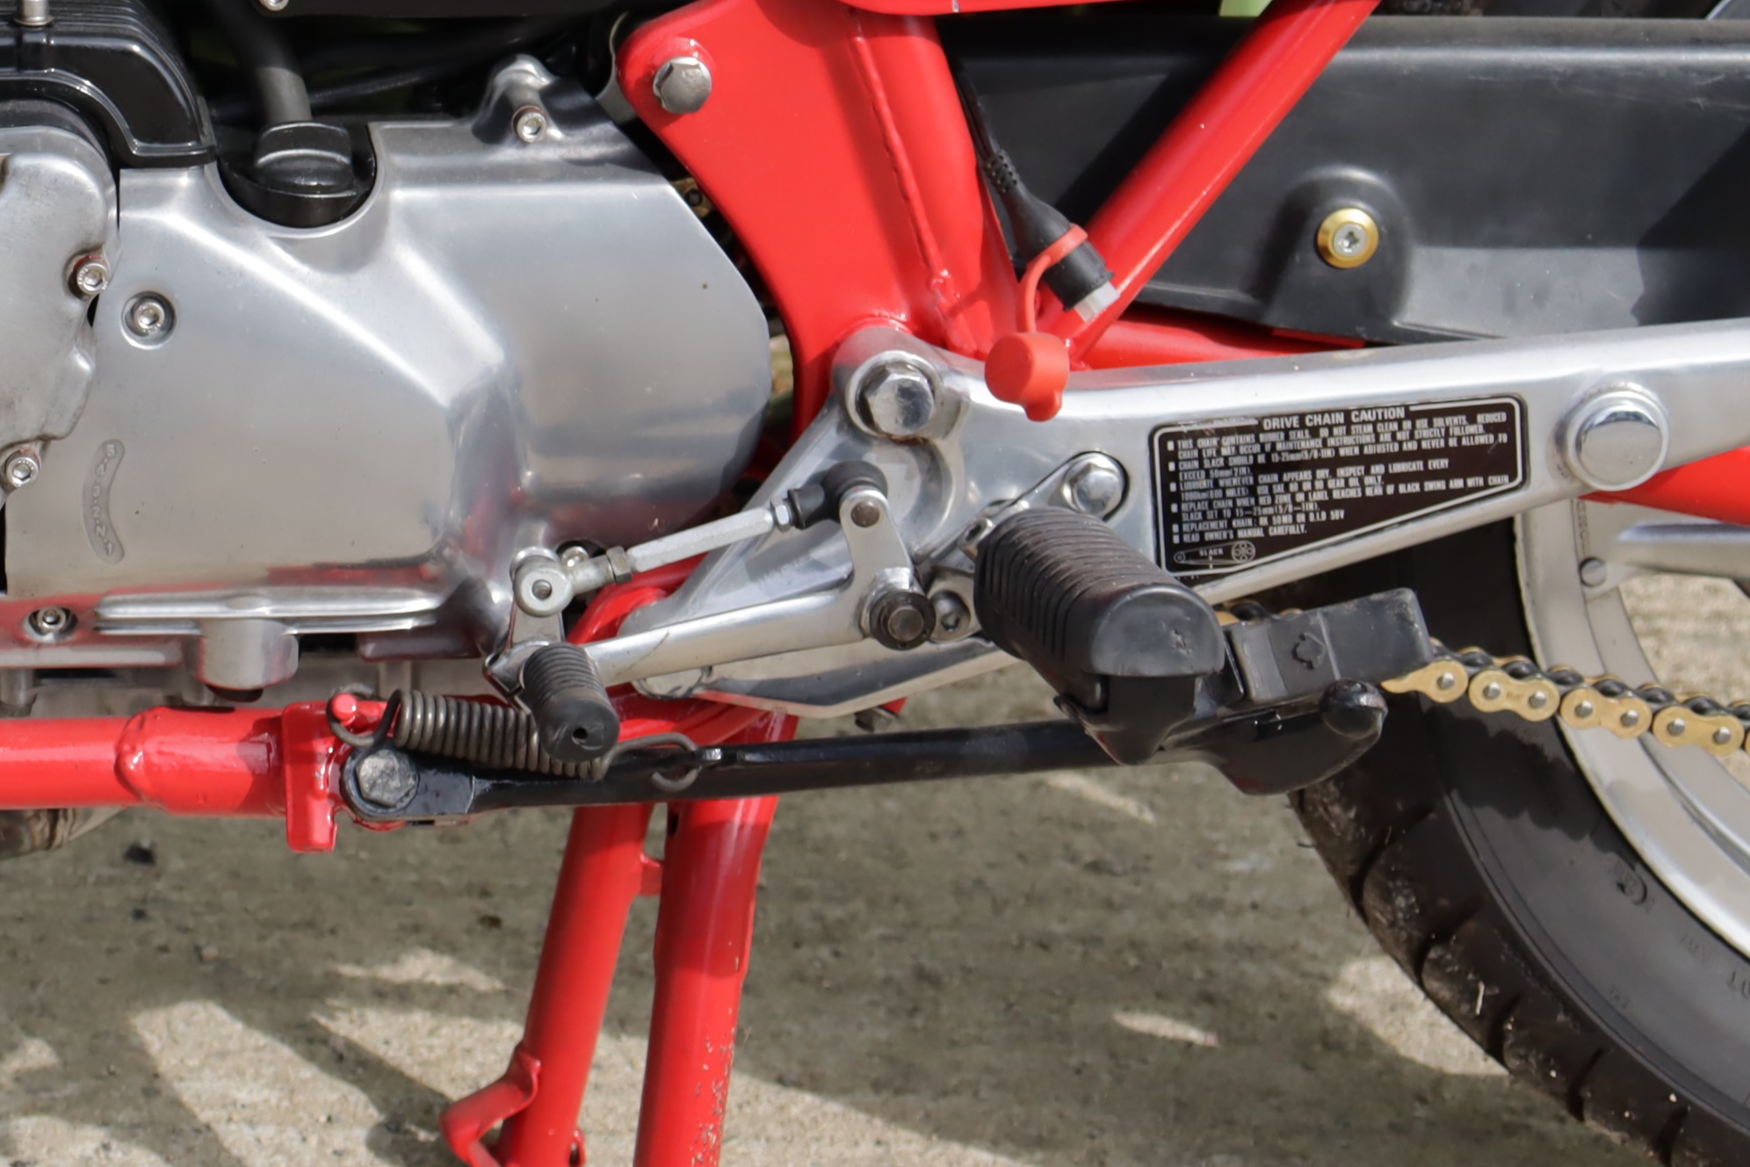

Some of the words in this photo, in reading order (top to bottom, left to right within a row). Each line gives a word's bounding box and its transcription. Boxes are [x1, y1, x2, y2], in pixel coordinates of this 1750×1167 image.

[1263, 416, 1299, 430] DRIVE
[1305, 412, 1344, 427] CHAIN
[1351, 407, 1405, 423] CAUTION
[1178, 438, 1193, 449] THIS
[1197, 436, 1220, 448] CHAIN
[1221, 433, 1255, 446] CONTAINS
[1320, 427, 1329, 438] DO
[1333, 426, 1346, 437] NOT
[1351, 423, 1373, 435] STEAM
[1377, 421, 1399, 433] CLEAN
[1402, 420, 1412, 431] OR
[1416, 419, 1429, 429] USE
[1476, 412, 1507, 424] REDUCED
[1178, 448, 1198, 460] CHAIN
[1202, 446, 1217, 458] LIFE
[1221, 445, 1236, 456] MAY
[1239, 443, 1261, 455] OCCUR
[1265, 442, 1271, 453] IF
[1276, 438, 1323, 452] MAINTENANCE
[1327, 433, 1376, 447] INSTRUCTIONS
[1380, 432, 1392, 443] ARE
[1396, 430, 1410, 442] NOT
[1414, 427, 1445, 440] STRICTLY
[1179, 459, 1199, 470] CHAIN
[1204, 457, 1224, 468] SLACK
[1229, 455, 1253, 466] SHOULD
[1258, 454, 1265, 464] BE
[1339, 446, 1360, 457] WHEN
[1364, 443, 1399, 455] ADJUSTED
[1402, 441, 1418, 452] AND
[1421, 439, 1445, 450] NEVER
[1448, 437, 1458, 448] BE
[1462, 434, 1495, 447] ALLOWED
[1498, 433, 1508, 444] TO
[1179, 470, 1206, 481] EXCEED
[1180, 479, 1213, 491] LUBRICATE
[1219, 475, 1253, 488] WHENEVER
[1258, 473, 1278, 485] CHAIN
[1283, 471, 1312, 483] APPEARS
[1336, 466, 1365, 478] INSPECT
[1370, 464, 1385, 475] AND
[1388, 461, 1424, 473] LUBRICATE
[1428, 459, 1449, 470] EVERY
[1257, 485, 1269, 495] USE
[1273, 483, 1285, 493] SAE
[1302, 481, 1312, 491] OR
[1327, 478, 1345, 489] GEAR
[1348, 477, 1360, 487] OIL
[1182, 500, 1208, 511] REPLACE
[1213, 498, 1233, 509] CHAIN
[1236, 496, 1255, 507] WHEN
[1259, 495, 1272, 505] RED
[1275, 493, 1291, 504] ZONE
[1296, 492, 1305, 502] ON
[1308, 490, 1329, 501] LABEL
[1332, 487, 1362, 499] REACHES
[1365, 486, 1383, 496] REAR
[1386, 485, 1395, 494] OF
[1398, 482, 1421, 493] BLACK
[1424, 480, 1446, 491] SWING
[1449, 479, 1464, 489] ARM
[1466, 477, 1484, 487] WITH
[1488, 475, 1510, 486] CHAIN
[1182, 511, 1203, 522] SLACK
[1207, 510, 1218, 520] SET
[1223, 509, 1231, 519] TO
[1183, 520, 1227, 532] REPLACEMENT
[1296, 513, 1306, 523] OR
[1183, 533, 1200, 543] READ
[1238, 527, 1264, 539] MANUAL
